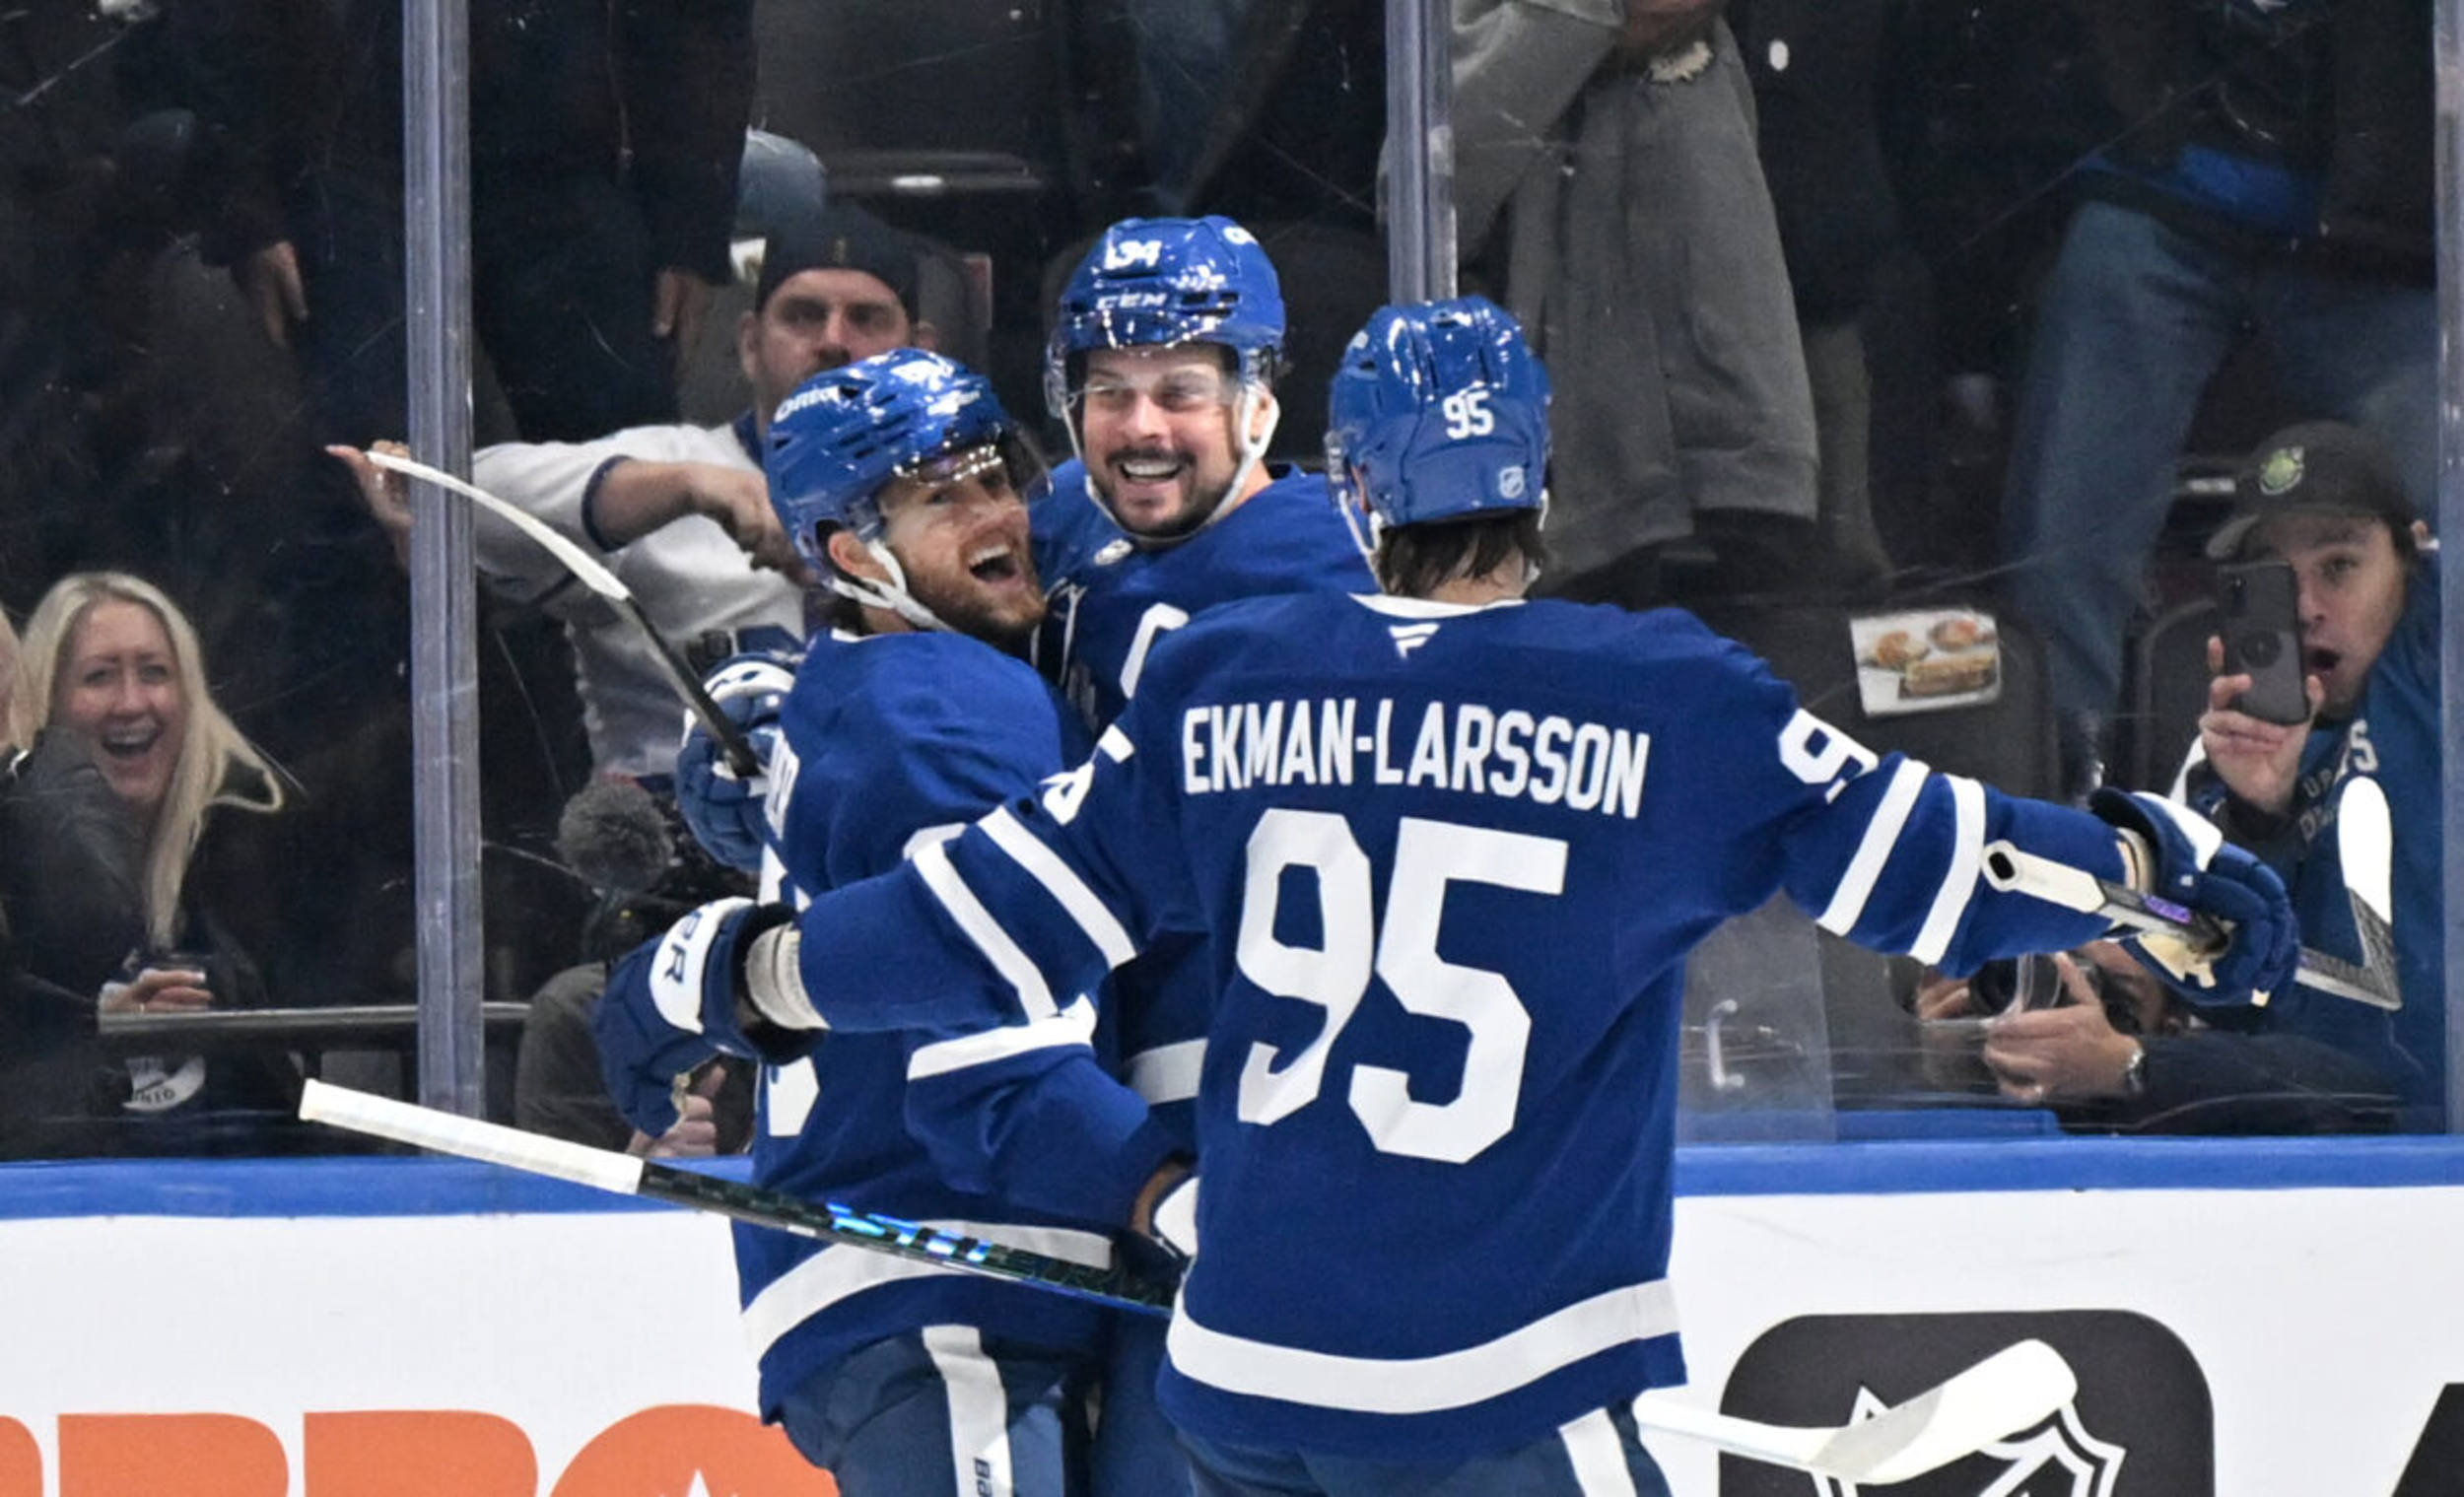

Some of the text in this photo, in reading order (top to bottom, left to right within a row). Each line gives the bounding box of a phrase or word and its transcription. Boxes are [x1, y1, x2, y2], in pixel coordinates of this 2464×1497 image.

[1442, 390, 1495, 440] 95
[1183, 698, 1650, 819] EKMAN-LARSSON
[1236, 807, 1569, 1165] 95
